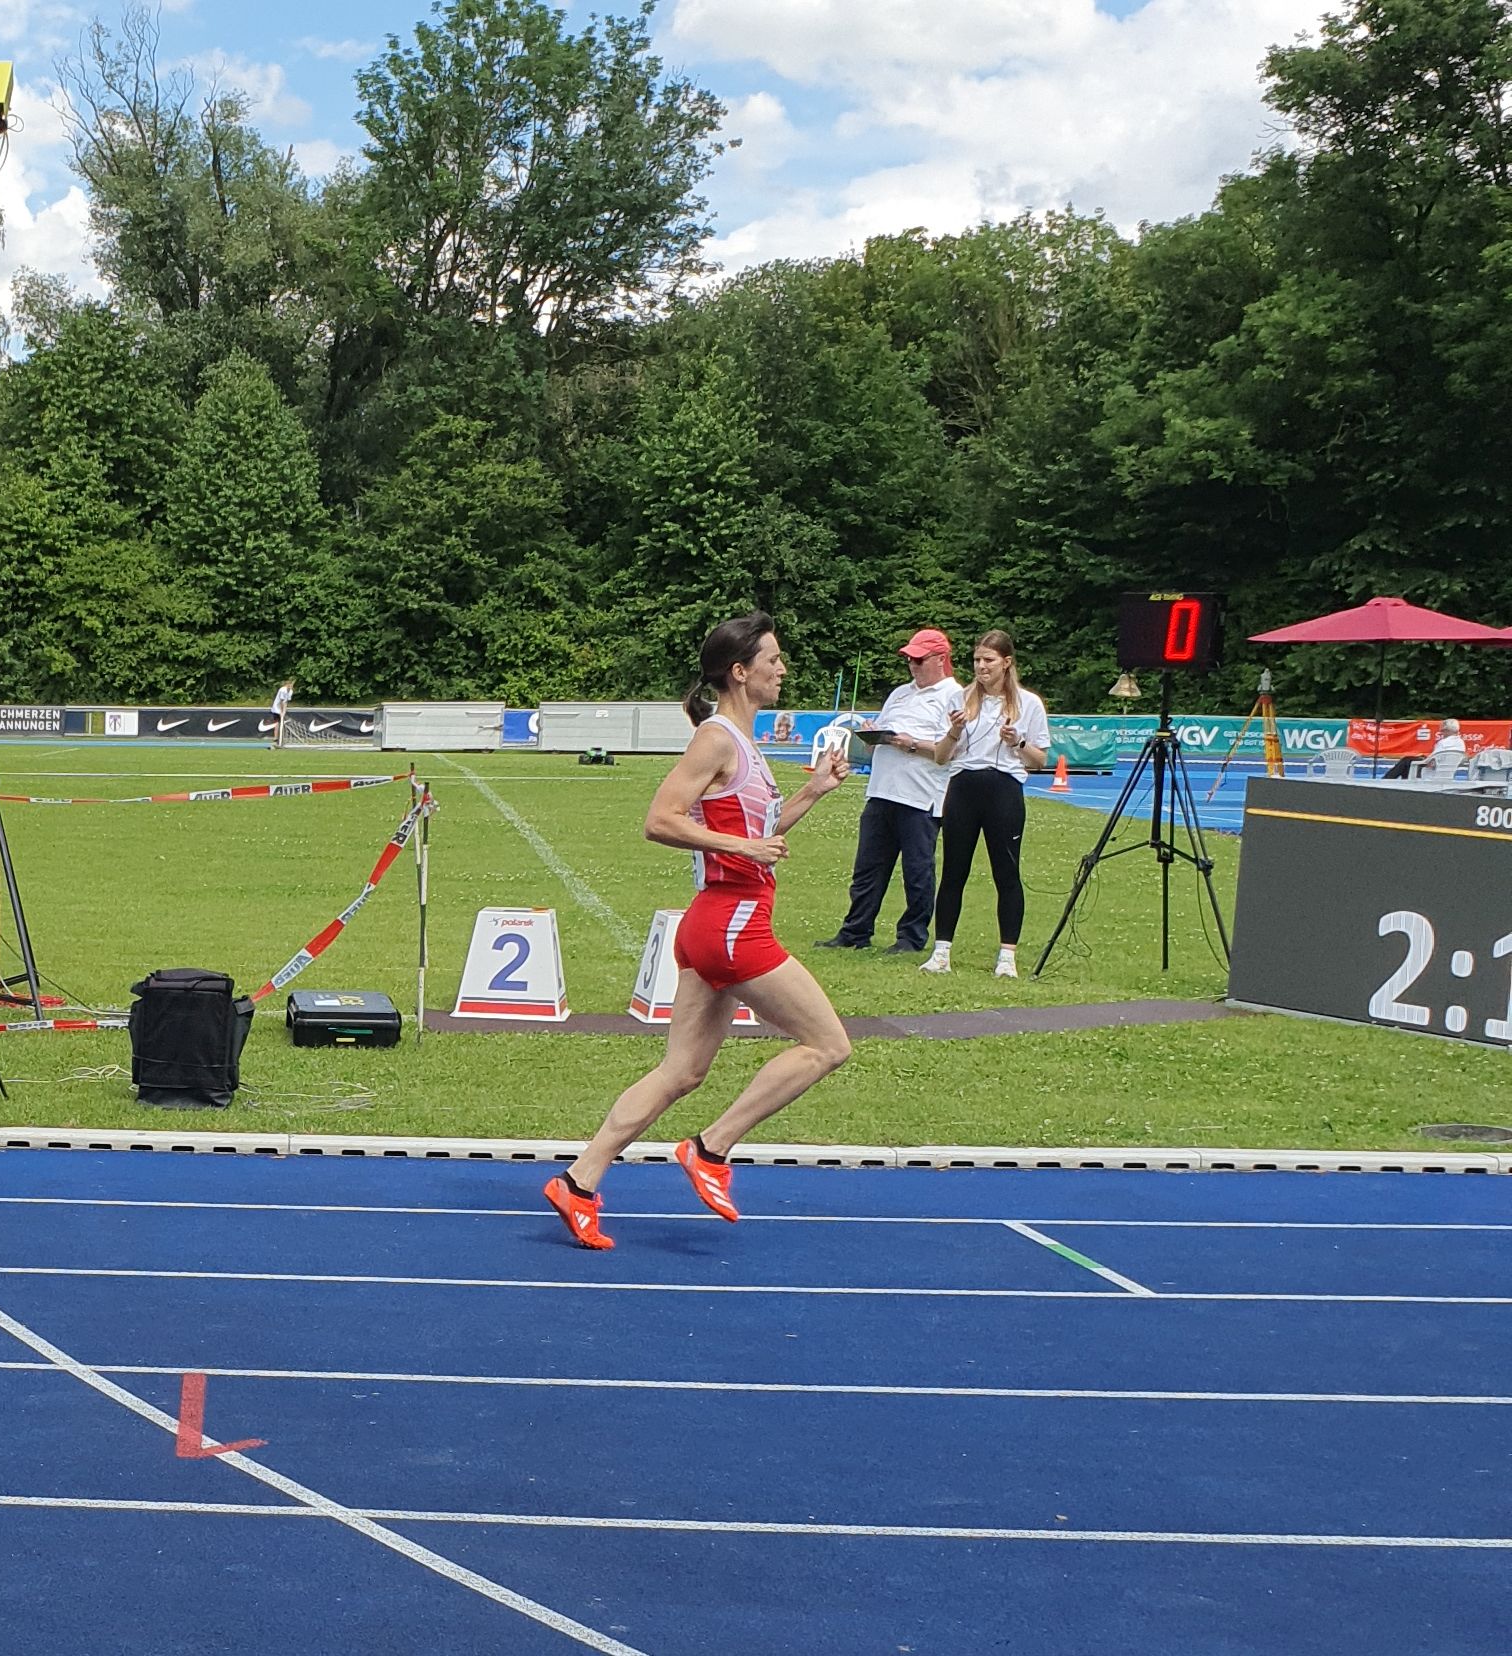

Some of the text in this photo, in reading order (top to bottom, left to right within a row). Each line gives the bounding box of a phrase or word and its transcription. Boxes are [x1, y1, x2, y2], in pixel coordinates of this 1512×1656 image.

[1163, 599, 1201, 662] 0
[1283, 728, 1345, 750] WGV
[488, 932, 531, 992] 2
[643, 932, 660, 990] 3
